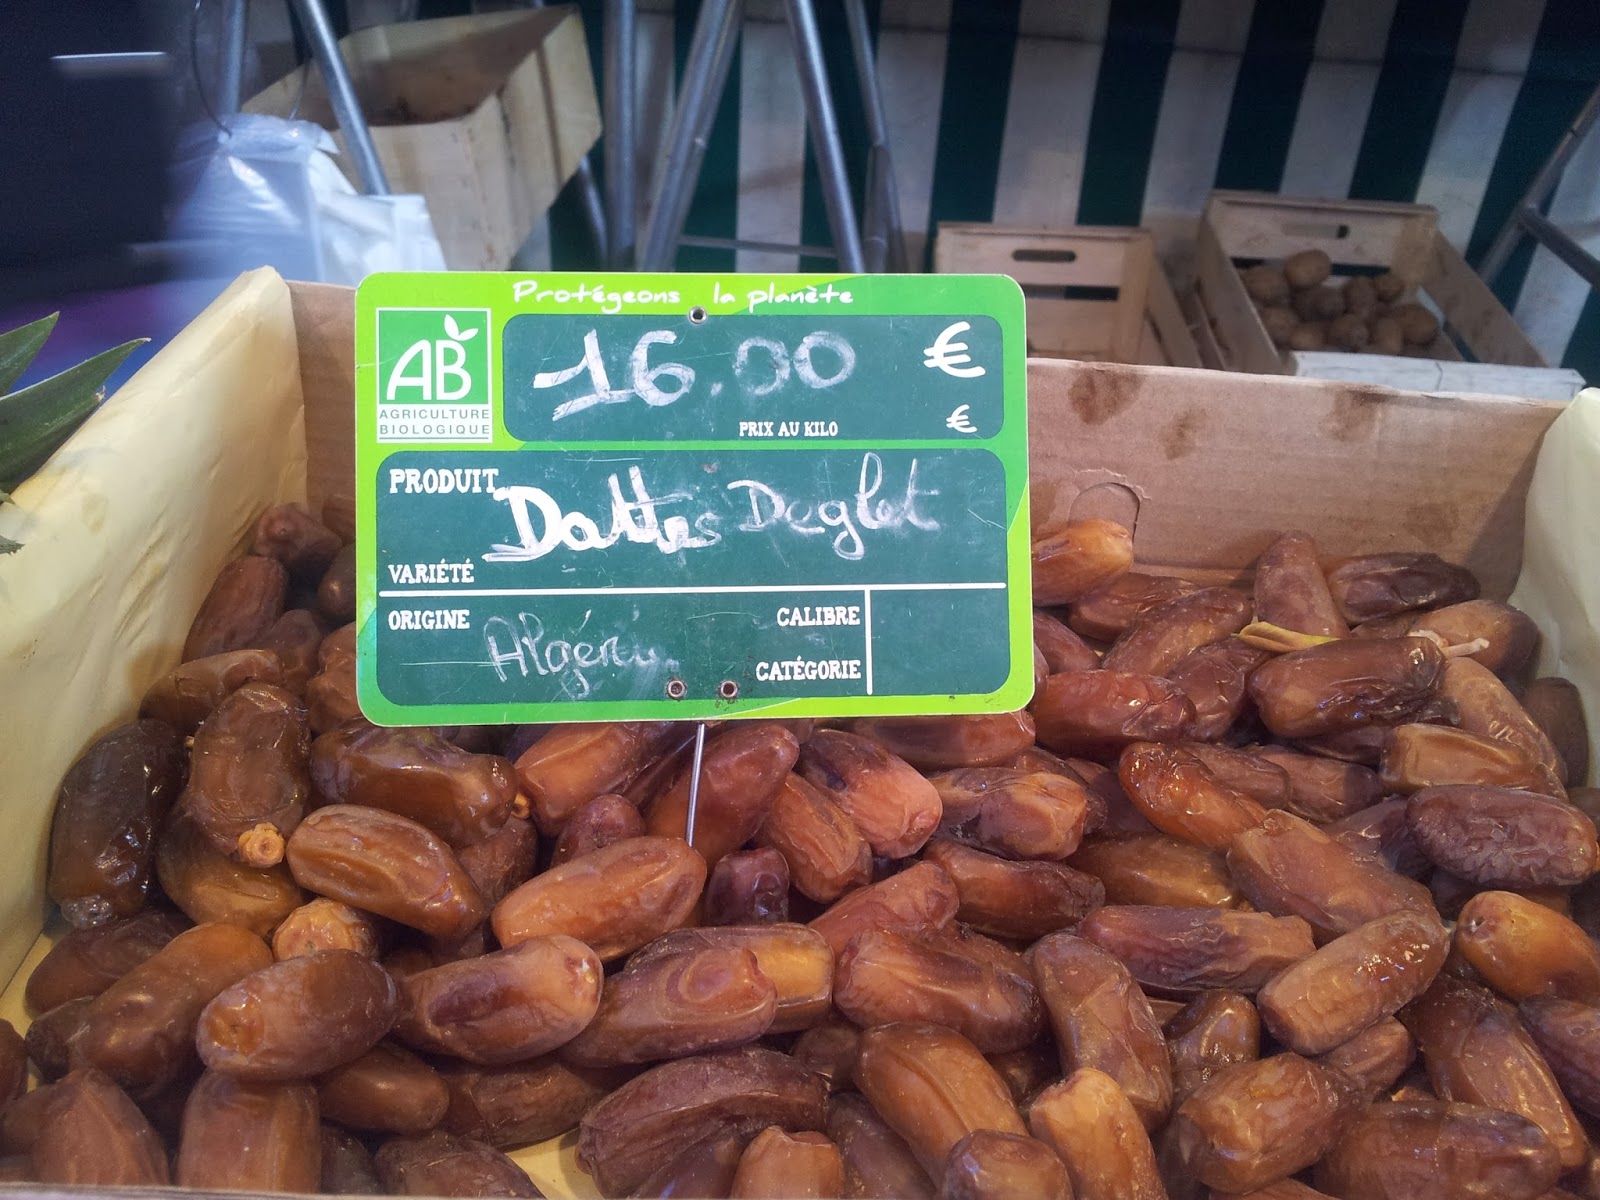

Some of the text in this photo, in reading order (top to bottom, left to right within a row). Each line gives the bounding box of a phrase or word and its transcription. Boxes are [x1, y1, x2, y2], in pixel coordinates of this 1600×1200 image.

[512, 280, 854, 314] Protégeons la planète
[923, 321, 986, 378] €
[386, 339, 472, 401] AB
[379, 409, 490, 420] AGRICULTURE
[946, 404, 978, 433] €
[379, 424, 490, 436] BIOLOGIQUE
[739, 421, 839, 437] PRIX AU KILO
[389, 468, 499, 494] PRODUIT
[481, 465, 722, 562] Dattes
[388, 558, 475, 584] VARIÉTÉ
[388, 609, 470, 630] ORIGINE
[776, 606, 861, 626] CALIBRE
[755, 656, 861, 681] CATÉGORIE
